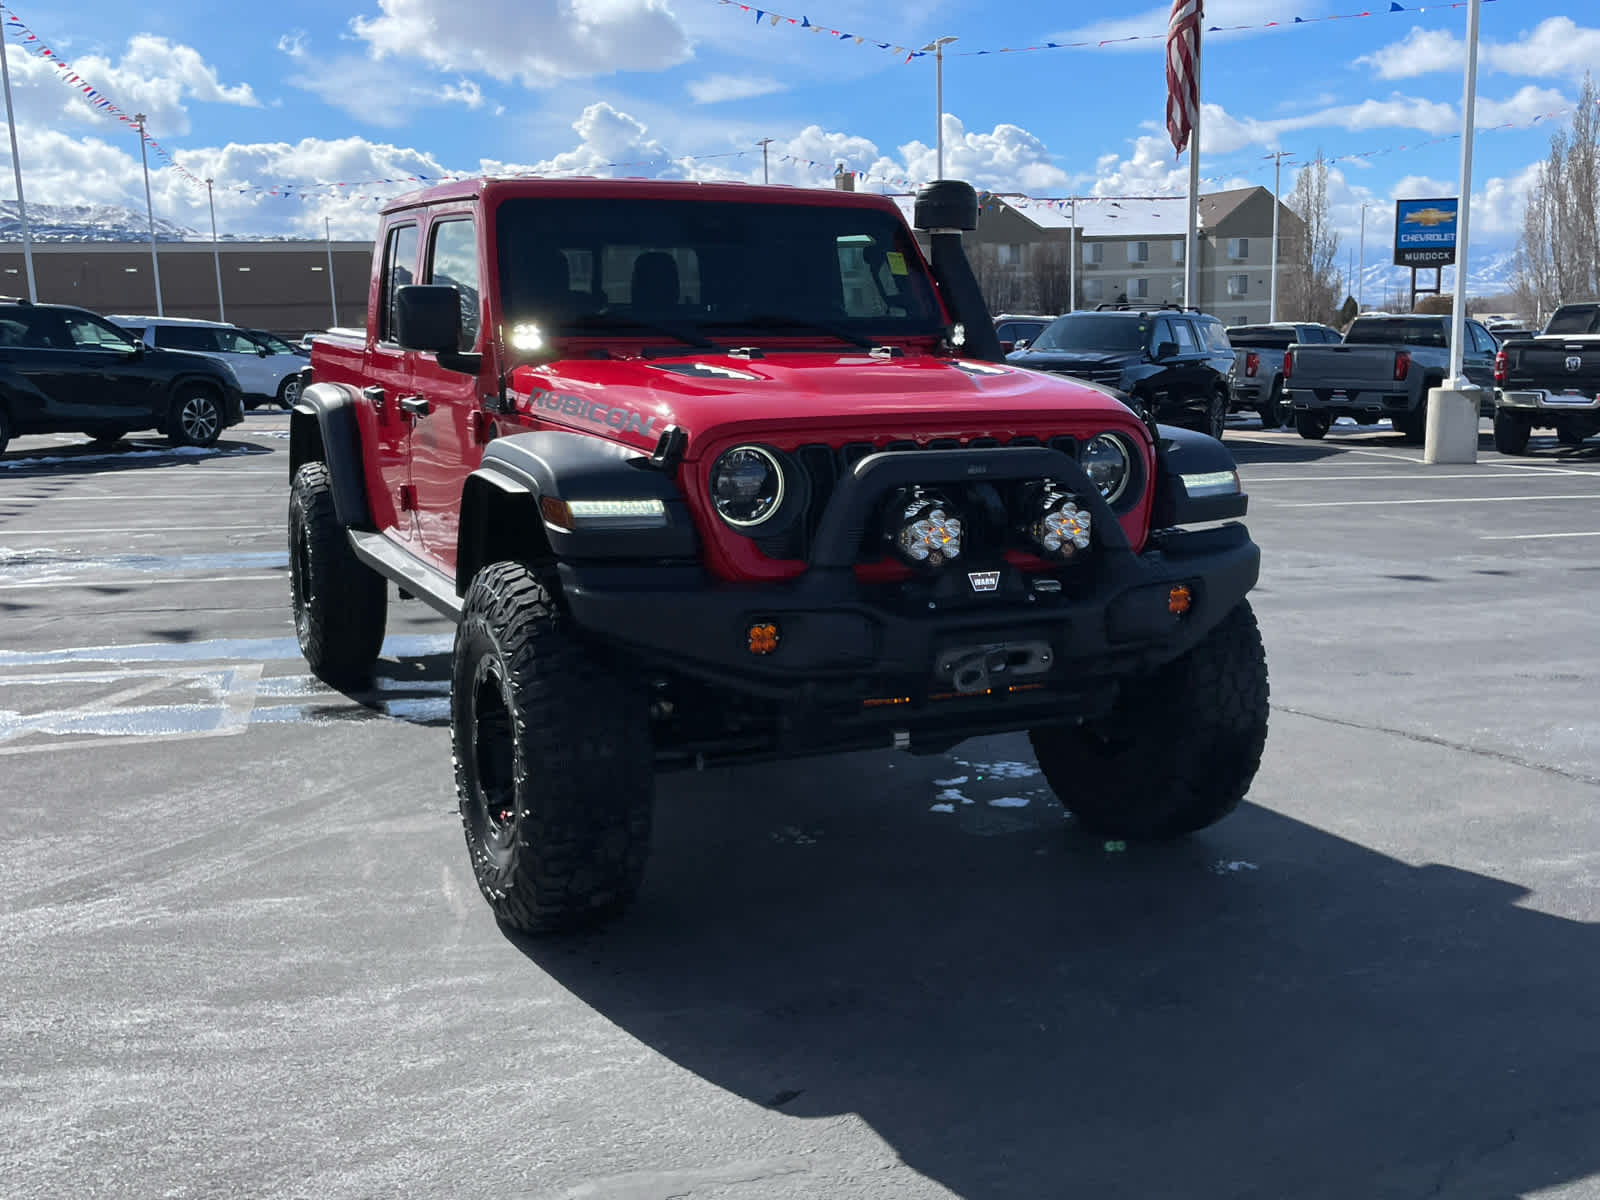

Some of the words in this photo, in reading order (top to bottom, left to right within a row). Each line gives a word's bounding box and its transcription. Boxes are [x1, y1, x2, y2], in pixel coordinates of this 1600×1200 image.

[1401, 233, 1456, 242] CHEVROLET
[1404, 251, 1450, 260] MURDOCK
[528, 387, 656, 436] RUBICON
